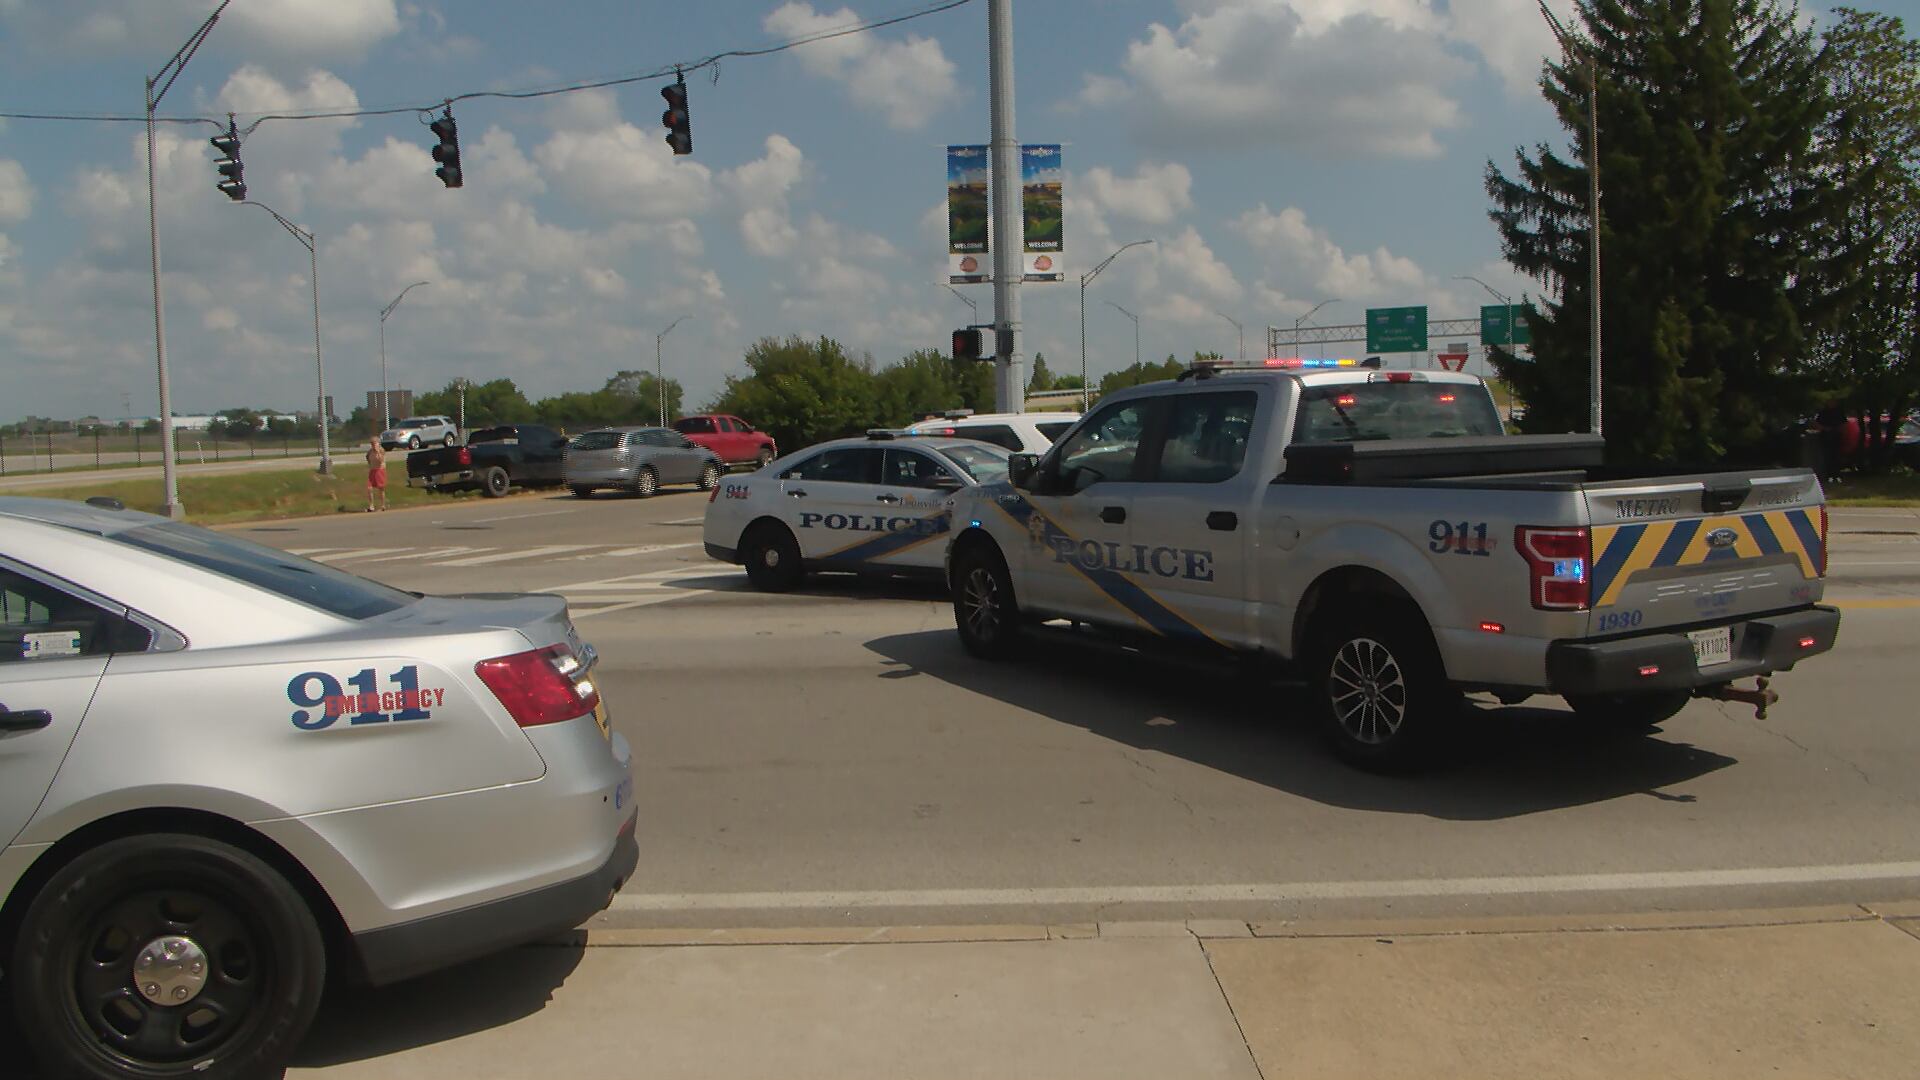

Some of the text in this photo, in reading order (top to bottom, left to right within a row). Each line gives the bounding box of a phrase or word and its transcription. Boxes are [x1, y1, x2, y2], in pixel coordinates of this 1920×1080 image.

[726, 484, 749, 499] 911
[1615, 497, 1680, 518] METRO
[800, 512, 947, 533] POLICE
[1429, 519, 1490, 557] 911
[1051, 535, 1214, 582] POLICE
[1598, 609, 1643, 632] 1930
[286, 665, 431, 730] 911
[324, 687, 445, 717] EMERGENCY
